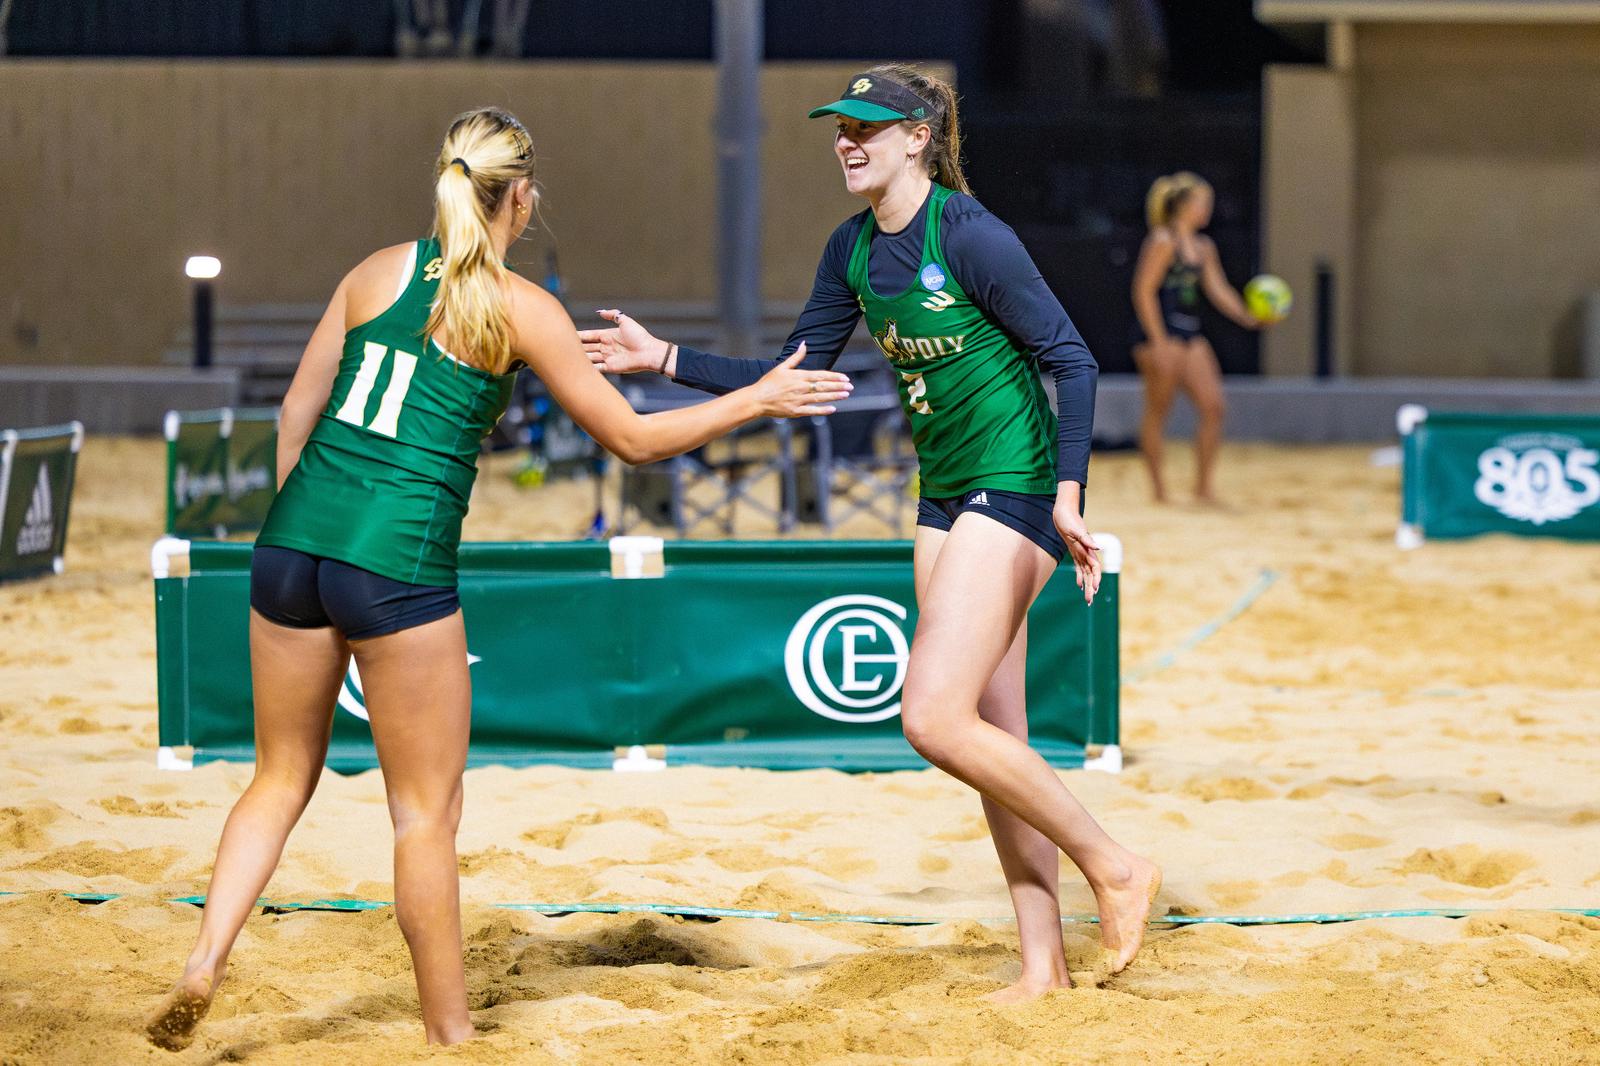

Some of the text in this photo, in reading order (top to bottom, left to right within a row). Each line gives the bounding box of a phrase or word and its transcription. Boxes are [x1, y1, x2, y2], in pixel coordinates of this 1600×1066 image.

[900, 335, 967, 360] POLY
[335, 341, 419, 438] 11
[900, 371, 934, 415] 2
[1473, 446, 1600, 508] 805
